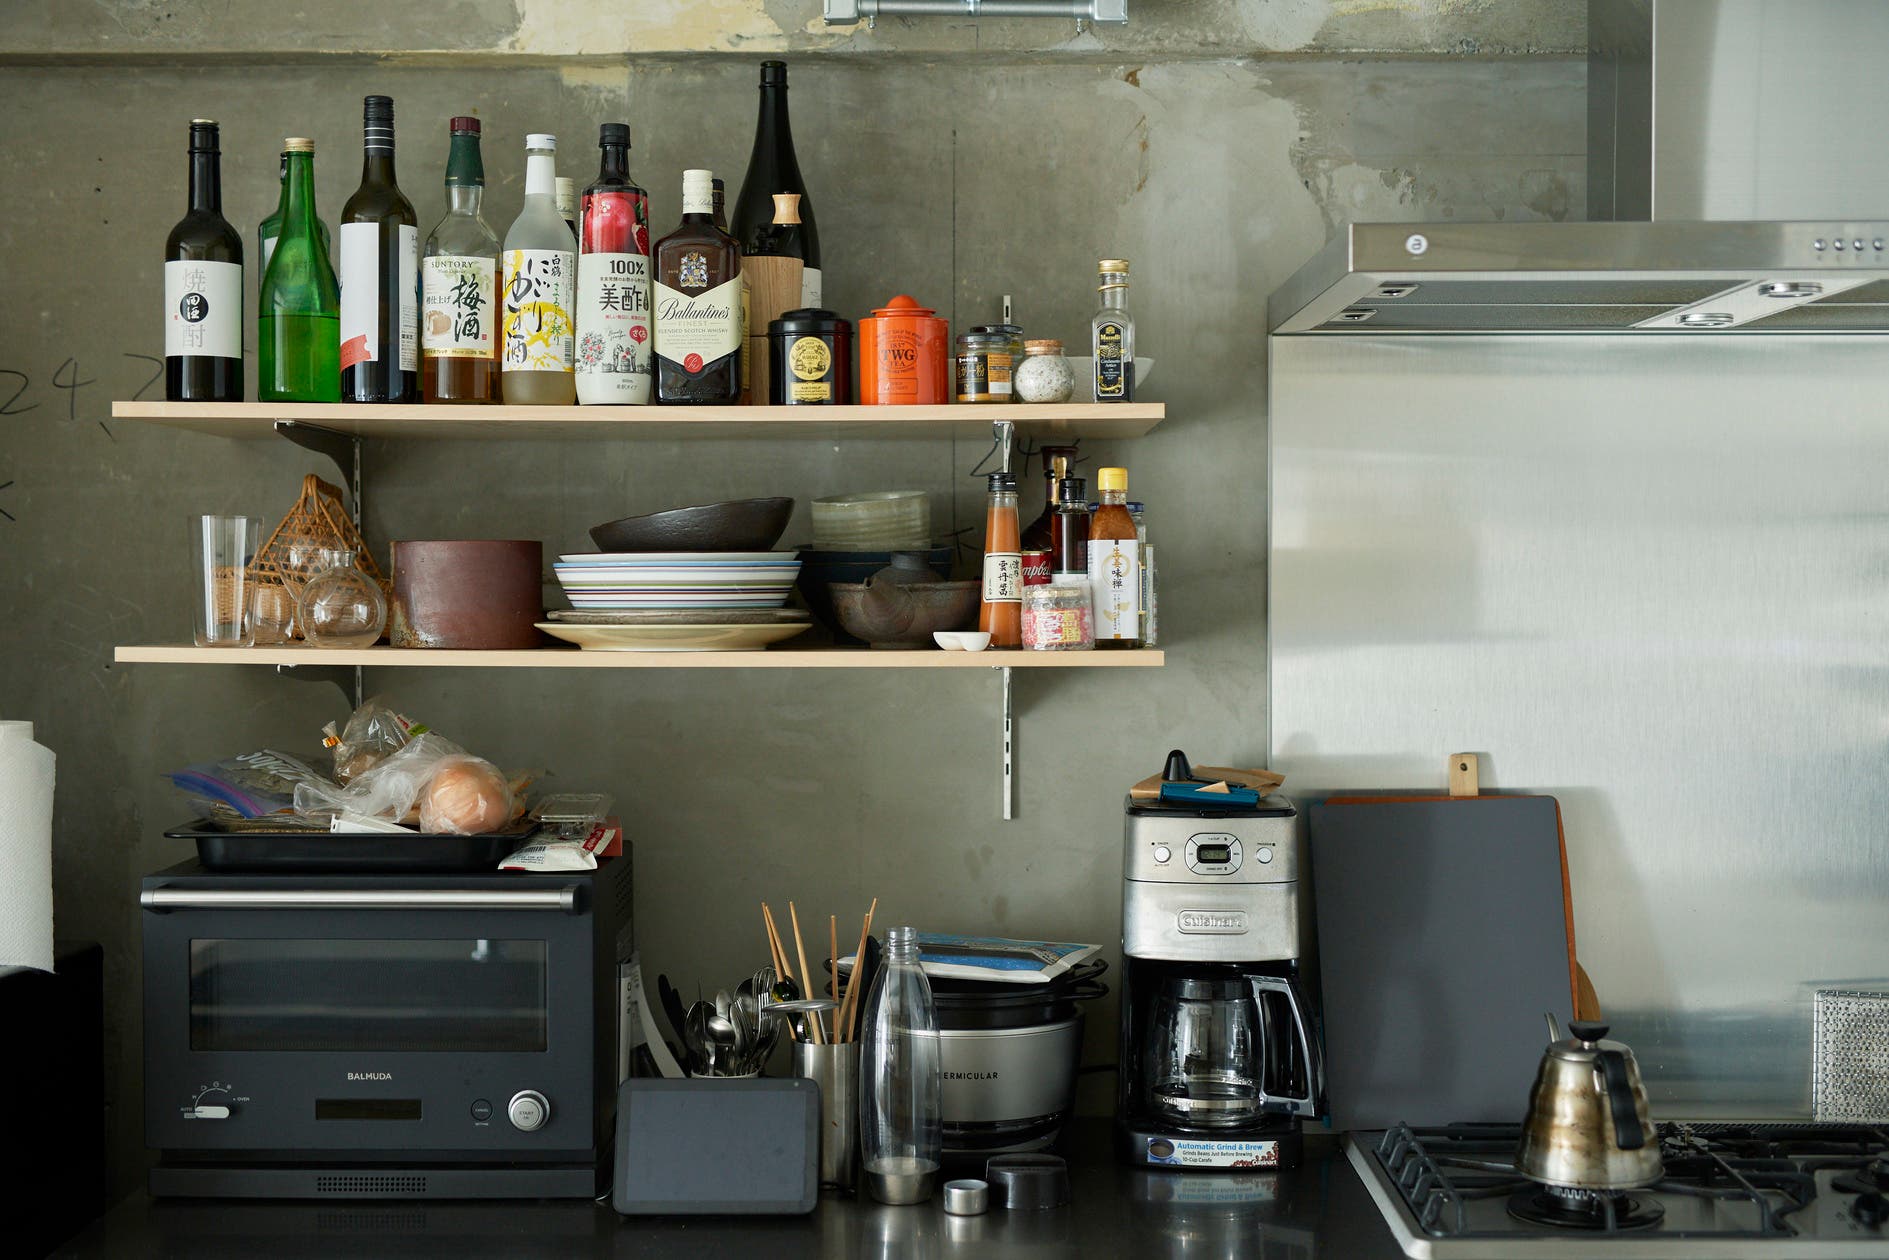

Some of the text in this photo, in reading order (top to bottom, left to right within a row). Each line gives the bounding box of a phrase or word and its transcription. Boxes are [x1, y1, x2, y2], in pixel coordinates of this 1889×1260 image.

[431, 261, 474, 269] SUNTORY
[609, 260, 645, 275] 100%
[599, 283, 643, 312] 美酢
[450, 273, 487, 342] 梅酒
[657, 298, 730, 321] Ballantine's
[881, 349, 915, 361] TWG
[1183, 914, 1242, 928] Cuisinart
[347, 1073, 392, 1081] BALMUDA
[943, 1071, 998, 1080] ERMICULAR
[1177, 1142, 1213, 1150] Automatic
[1216, 1143, 1237, 1151] Grind
[1245, 1143, 1263, 1151] Brew
